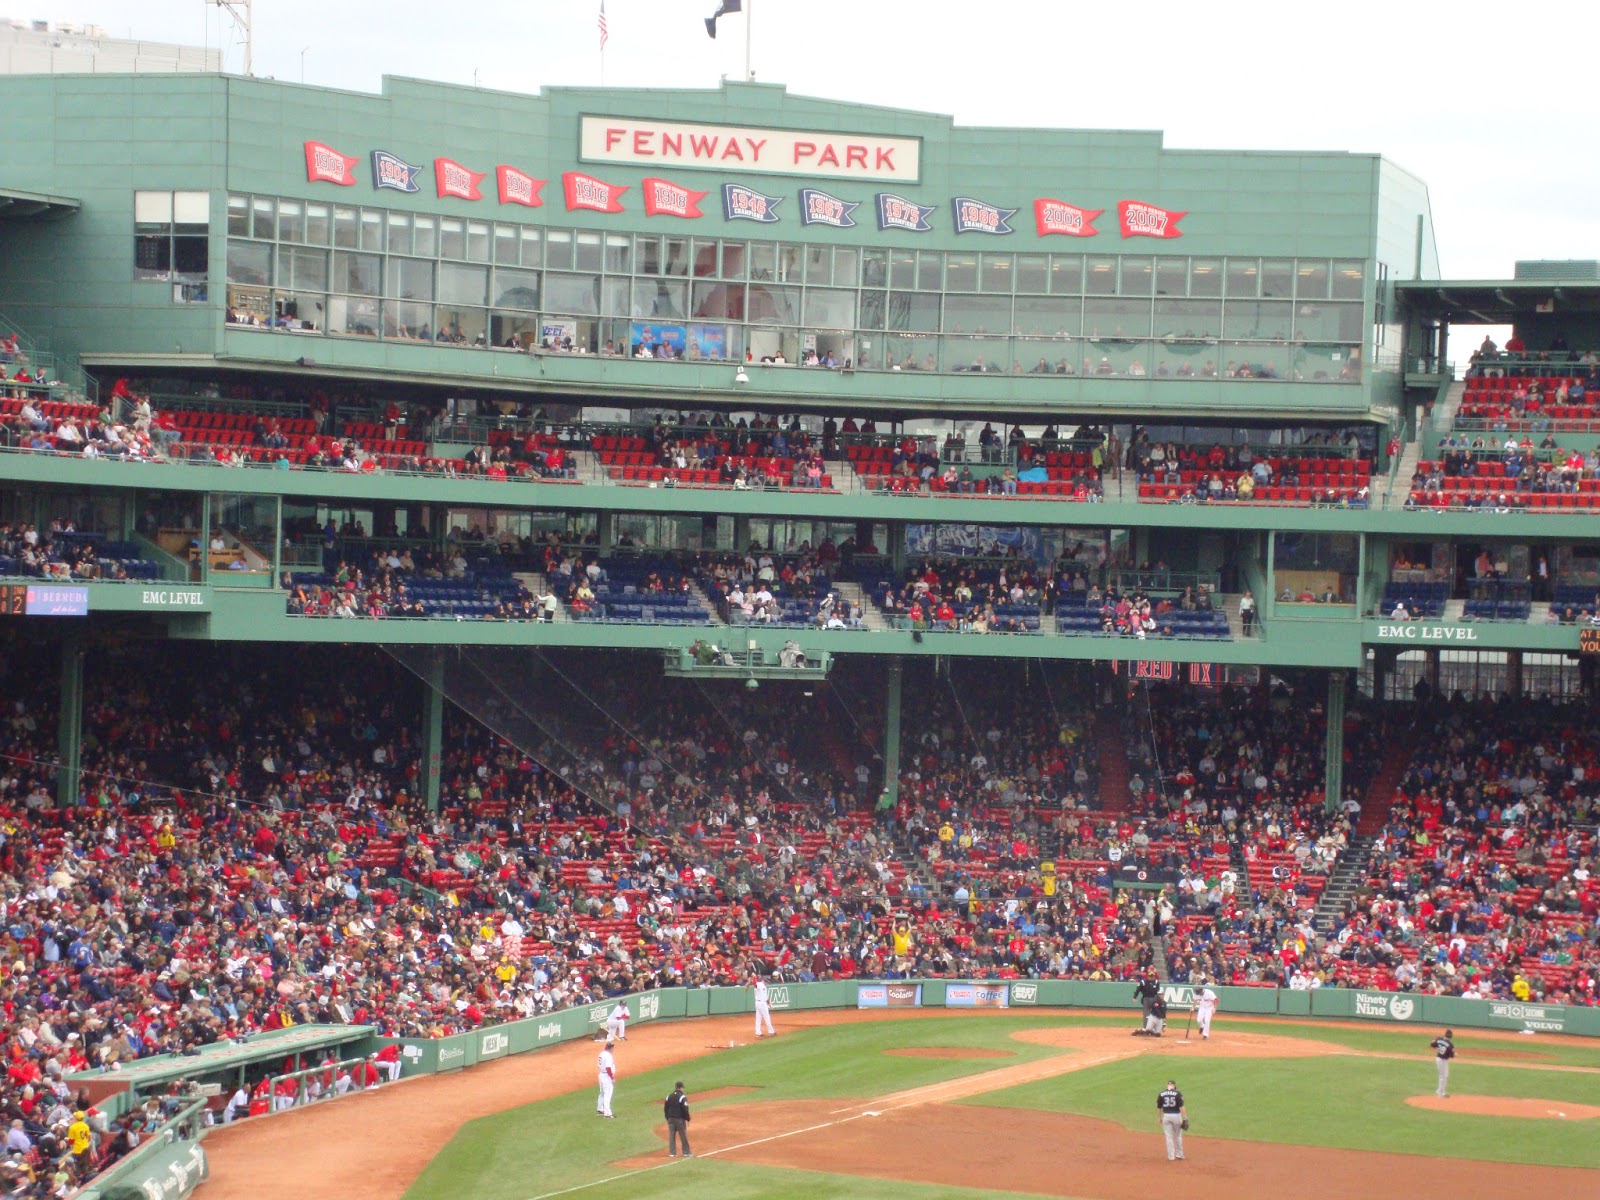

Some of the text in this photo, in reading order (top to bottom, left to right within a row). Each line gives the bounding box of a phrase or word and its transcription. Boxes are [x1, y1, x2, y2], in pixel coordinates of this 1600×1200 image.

[607, 128, 895, 170] FENWAY PARK
[315, 152, 344, 175] 1903
[380, 161, 408, 185] 1904
[445, 168, 470, 190] 1912
[507, 175, 531, 197] 1915
[576, 183, 608, 204] 1916
[655, 188, 686, 208] 1918
[732, 193, 766, 214] 1946
[809, 198, 844, 218] 1967
[886, 202, 919, 223] 1975
[962, 206, 999, 226] 1986
[1044, 208, 1082, 227] 2004
[1126, 209, 1168, 229] 2007
[1130, 225, 1164, 236] CHAMPIONS
[14, 596, 22, 613] 2
[42, 592, 88, 602] BERMUDA
[143, 591, 203, 605] EMC LEVEL
[1378, 626, 1477, 640] EMC LEVEL
[976, 991, 1002, 1000] coffee
[1356, 994, 1388, 1005] Ninety
[1356, 1003, 1386, 1016] Nine
[1493, 1005, 1507, 1014] SAFE
[1524, 1021, 1563, 1030] VOLVO
[1163, 1097, 1176, 1107] 35
